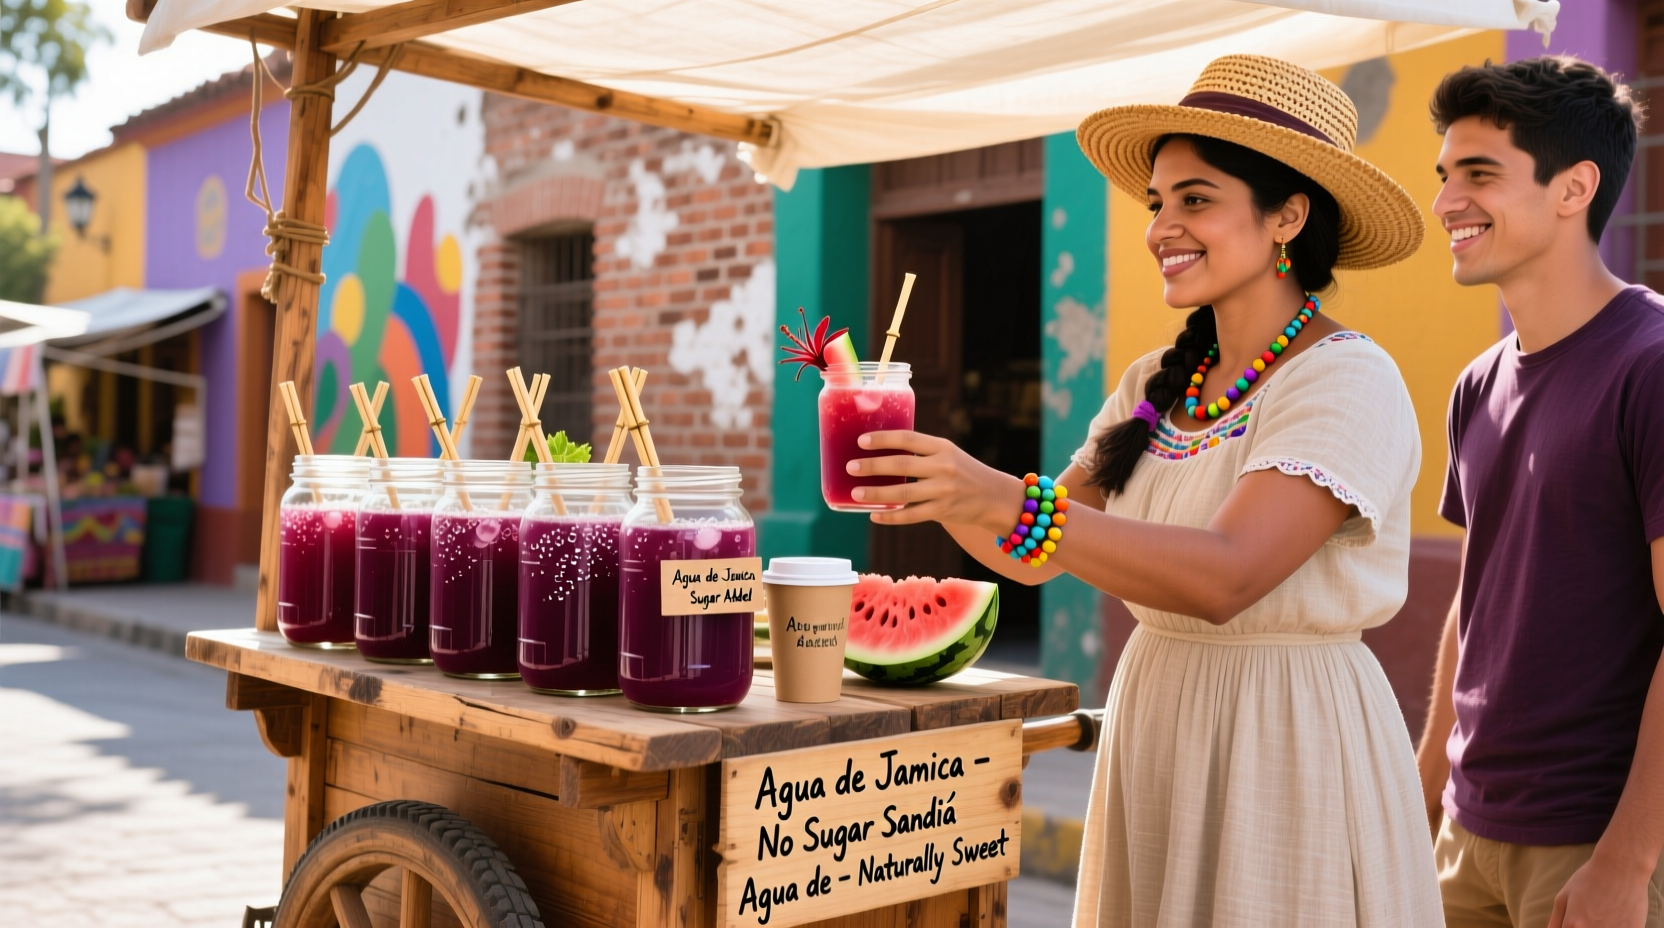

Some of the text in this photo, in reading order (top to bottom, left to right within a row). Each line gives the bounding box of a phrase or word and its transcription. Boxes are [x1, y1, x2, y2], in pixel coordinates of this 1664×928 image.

[672, 569, 701, 589] Agua
[706, 567, 719, 582] de
[690, 590, 721, 610] Sugar
[755, 766, 825, 820] Agua
[835, 758, 866, 795] de
[875, 749, 964, 790] Jamica
[758, 790, 956, 862] No Sugar Sandiá
[738, 876, 798, 925] Agua
[806, 864, 831, 898] de
[858, 842, 944, 885] Naturally
[951, 828, 1009, 866] Sweet
